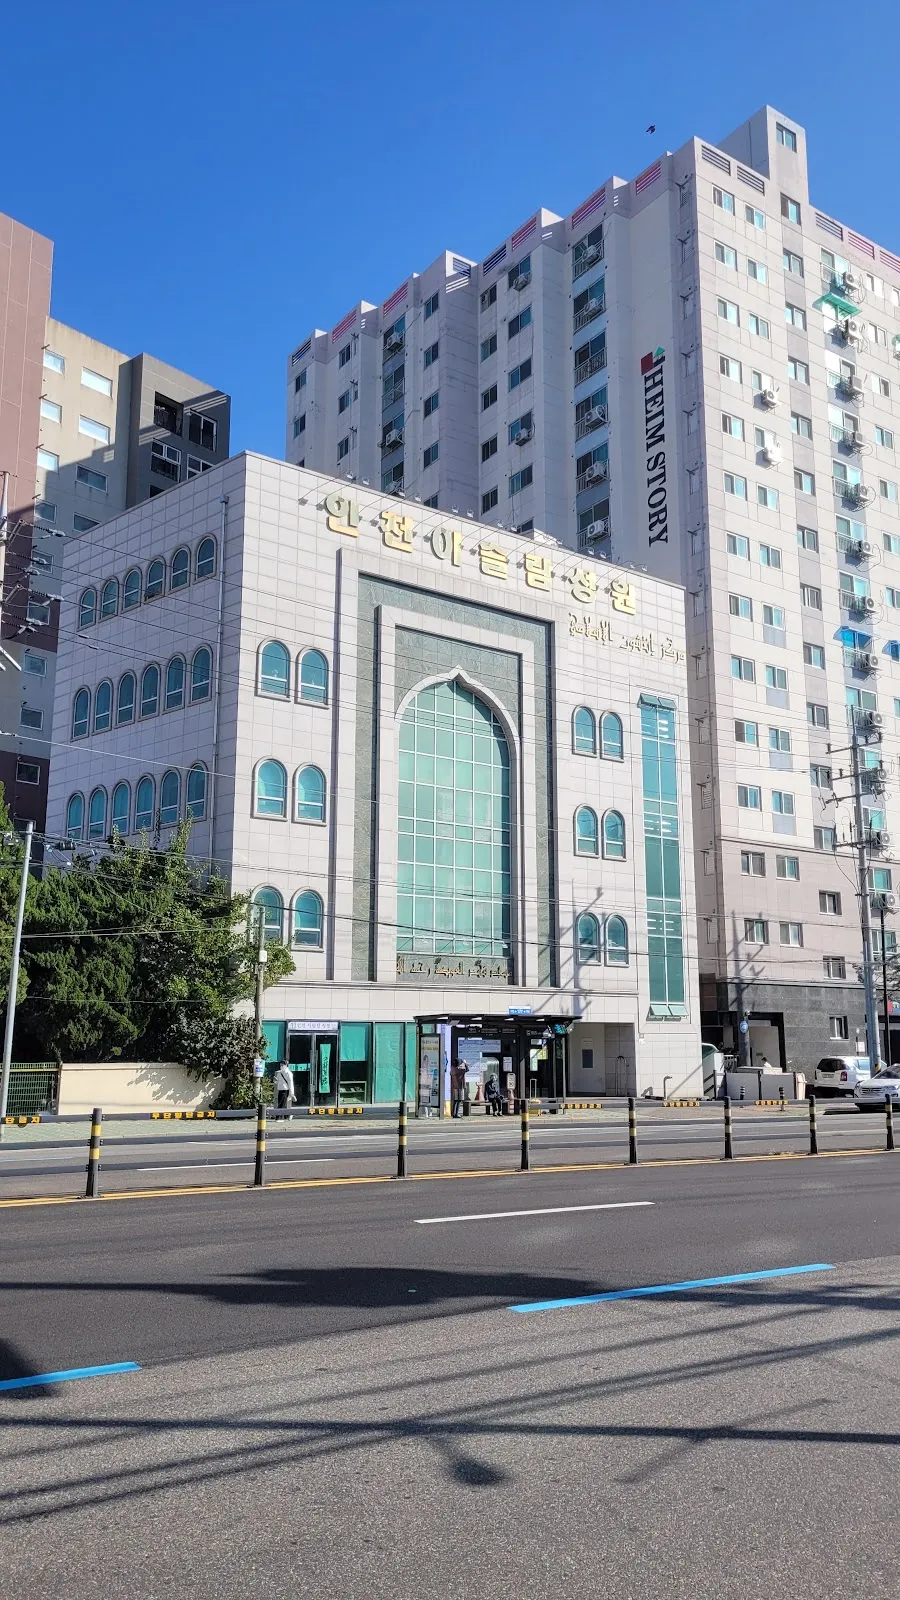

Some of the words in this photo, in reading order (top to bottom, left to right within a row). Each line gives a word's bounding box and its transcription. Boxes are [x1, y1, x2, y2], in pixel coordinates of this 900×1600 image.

[644, 365, 666, 452] HEIM
[646, 452, 668, 547] STORY
[661, 638, 687, 664] مركز
